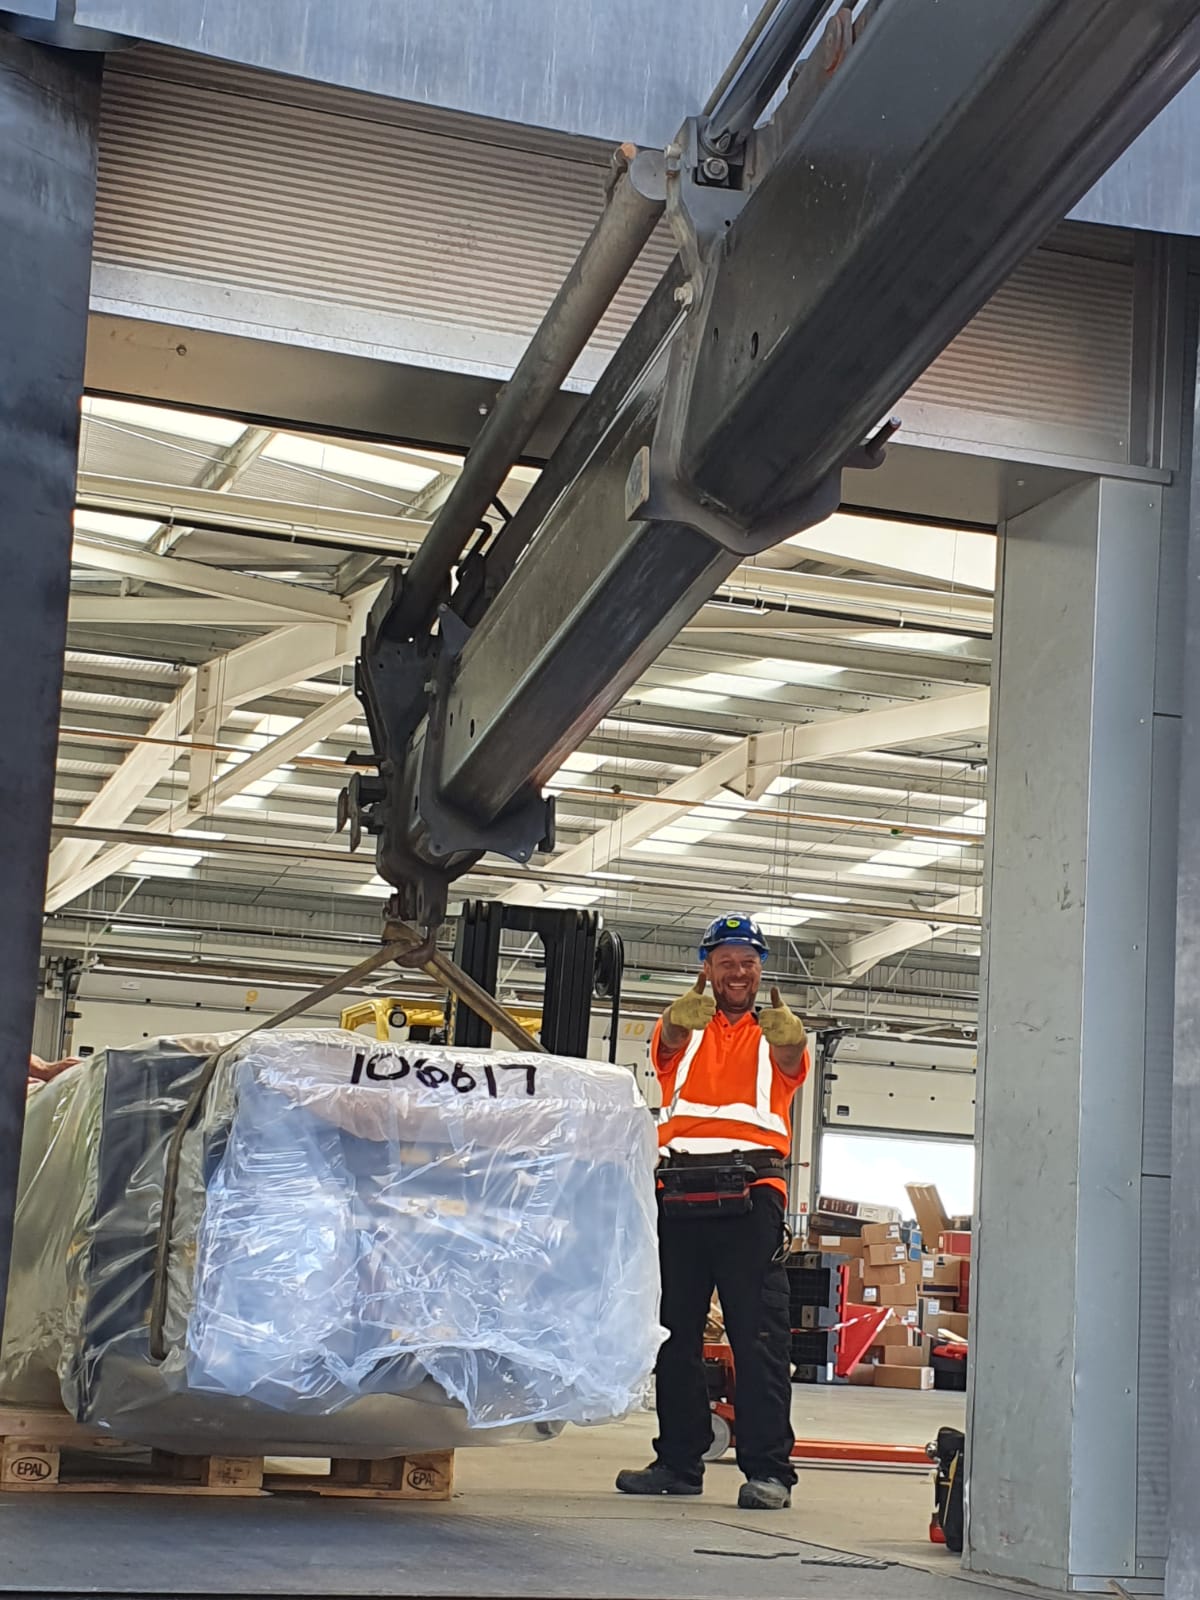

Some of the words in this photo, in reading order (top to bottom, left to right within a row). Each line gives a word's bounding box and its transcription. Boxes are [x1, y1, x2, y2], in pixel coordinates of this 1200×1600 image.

[624, 1022, 645, 1036] 10
[350, 1052, 537, 1098] 106617
[17, 1461, 47, 1477] EPAL
